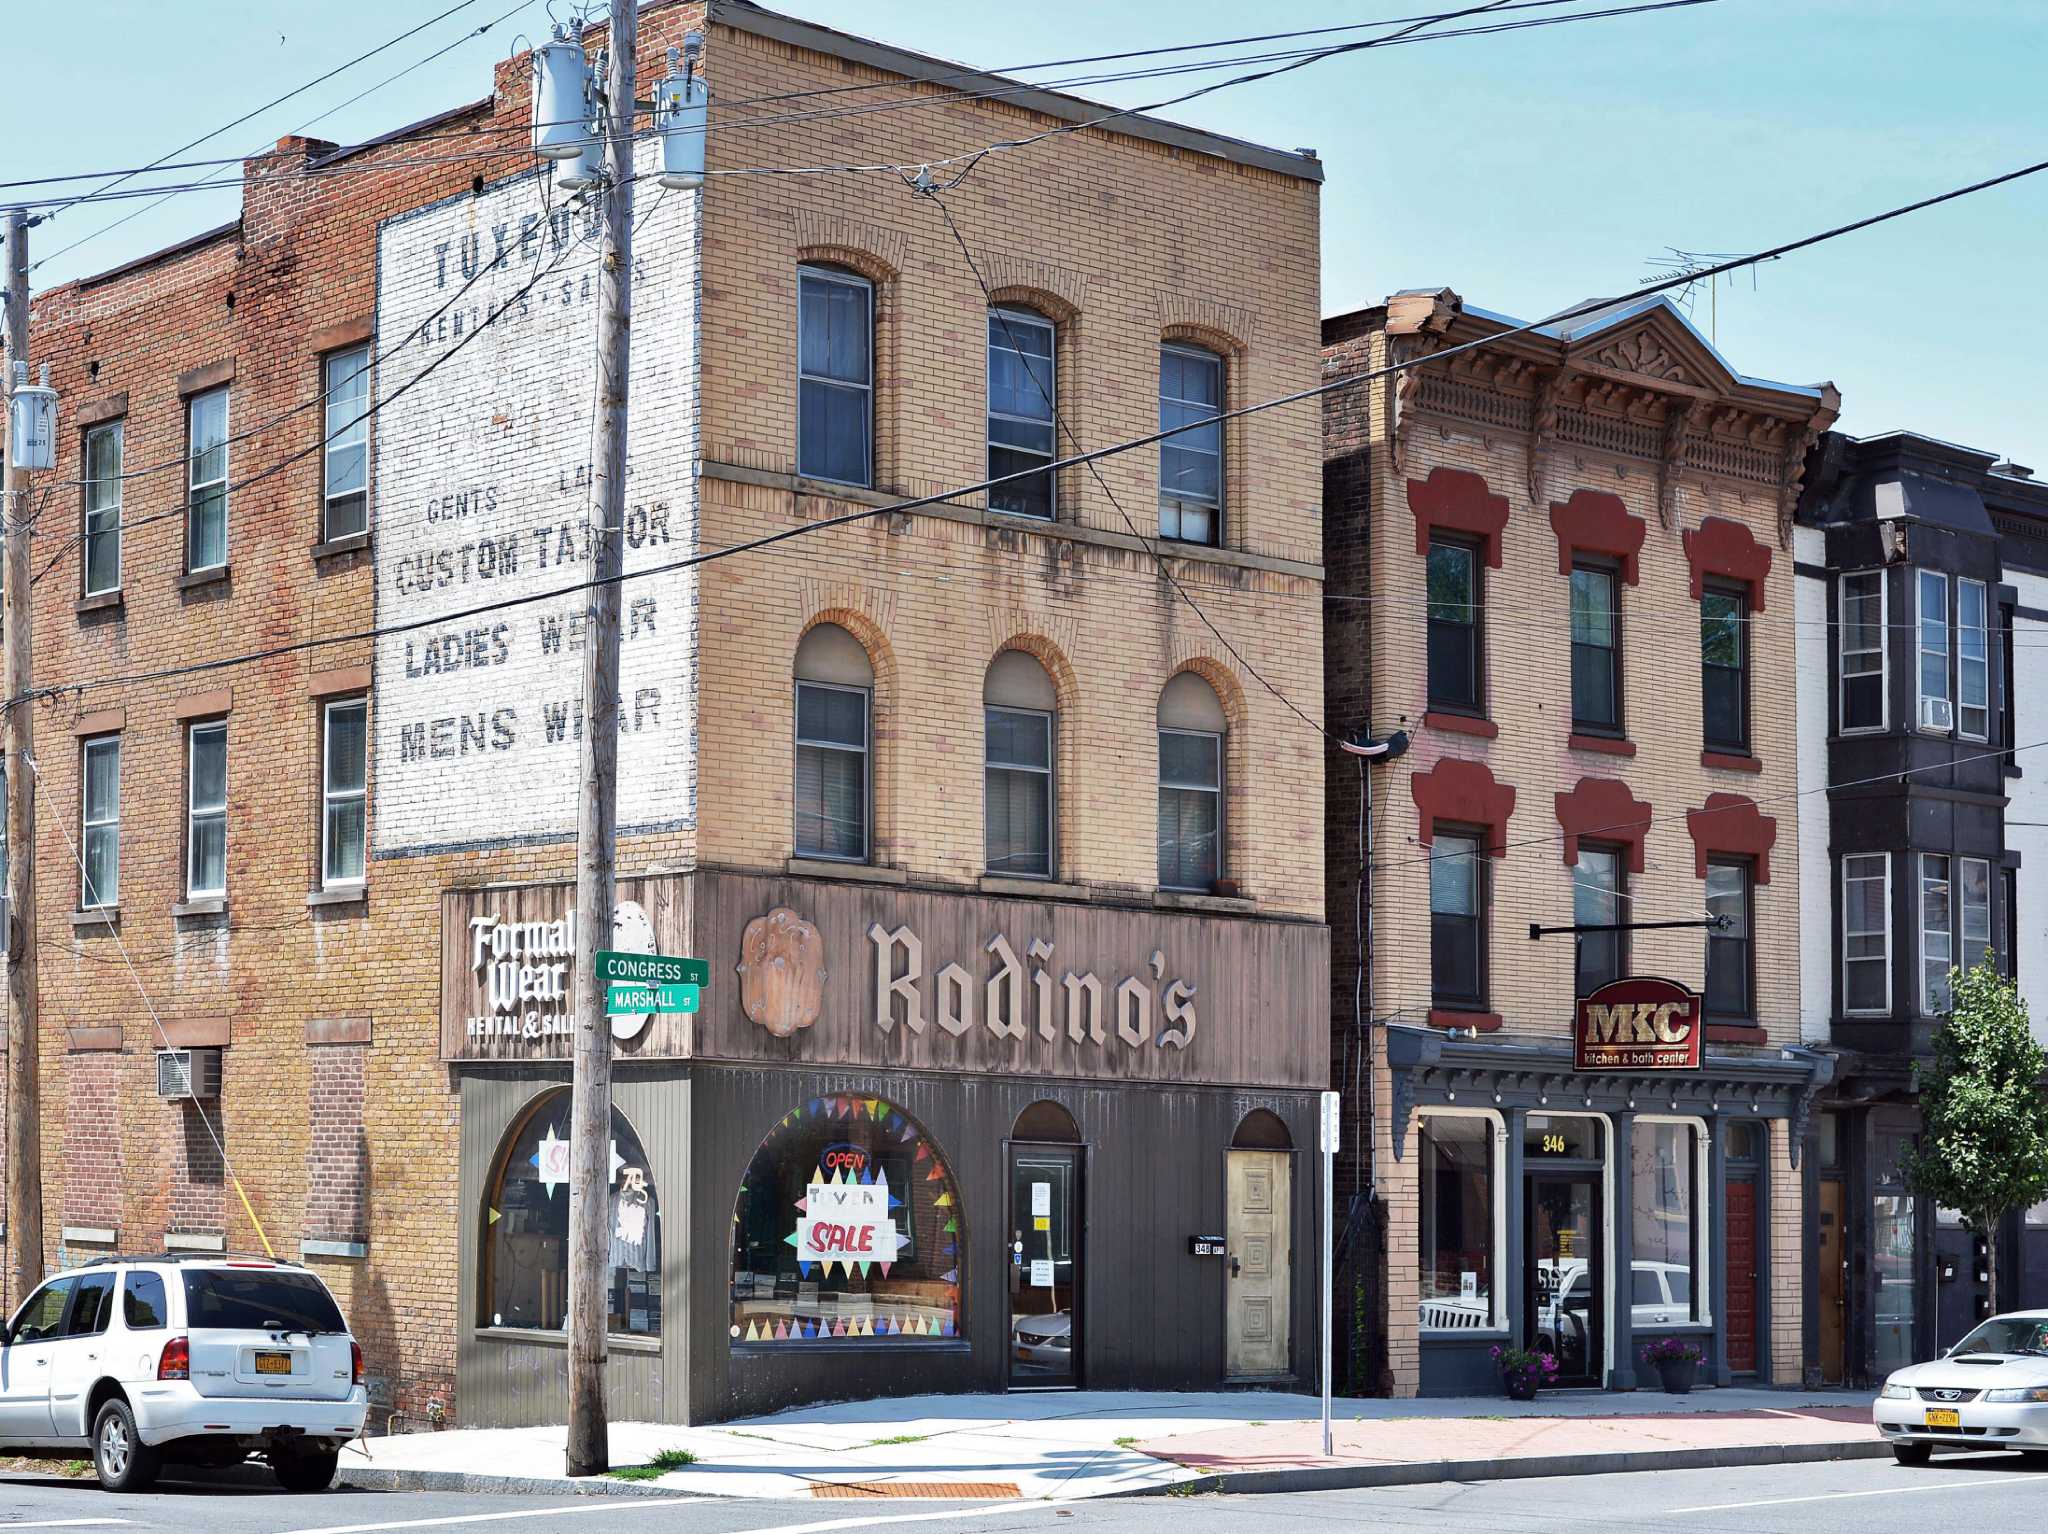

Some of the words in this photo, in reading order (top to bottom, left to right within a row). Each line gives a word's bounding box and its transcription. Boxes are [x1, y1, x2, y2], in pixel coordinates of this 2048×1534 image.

[427, 486, 498, 524] GENTS
[396, 533, 518, 595] CUSTOM
[533, 501, 671, 568] TAIOR
[405, 623, 509, 679] LADIES
[538, 597, 657, 655] WER
[400, 706, 516, 763] MENS
[469, 909, 576, 972] Formal
[487, 960, 568, 1012] Wear
[607, 959, 681, 980] CONGRESS
[690, 972, 698, 982] ST
[867, 922, 1197, 1051] Rodino's
[615, 990, 676, 1008] MARSHALL
[683, 997, 691, 1007] ST
[467, 1015, 520, 1036] RENTAL
[522, 1010, 544, 1039] &
[1585, 1002, 1691, 1043] MKC
[1584, 1053, 1619, 1064] kitchen
[1622, 1054, 1629, 1063] &
[1632, 1052, 1654, 1064] bath
[1656, 1052, 1689, 1065] center
[826, 1151, 864, 1168] OPEN
[1543, 1134, 1565, 1152] 346
[806, 1221, 875, 1252] SALE
